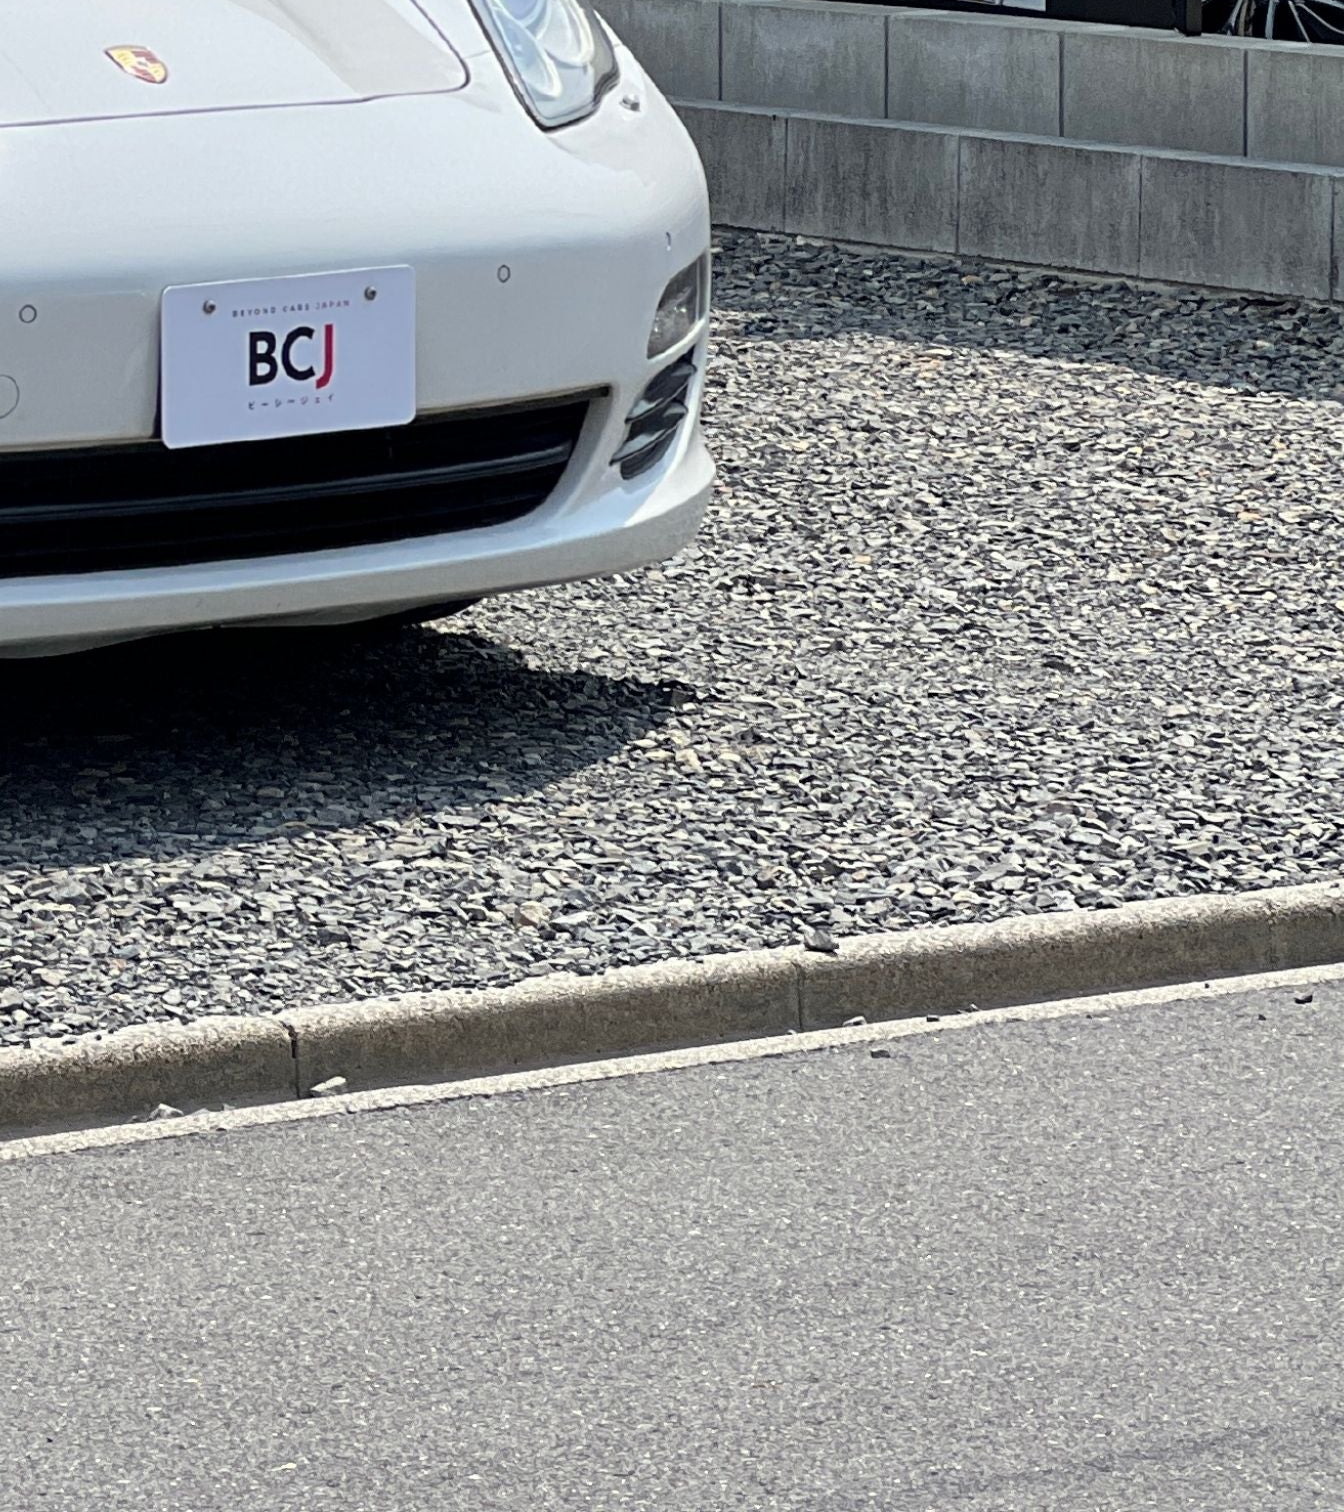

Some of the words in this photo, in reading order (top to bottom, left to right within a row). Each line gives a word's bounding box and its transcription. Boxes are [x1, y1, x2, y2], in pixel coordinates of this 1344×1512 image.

[231, 305, 277, 319] BEYOND
[314, 299, 351, 311] JAPAN
[248, 323, 334, 390] BCJ
